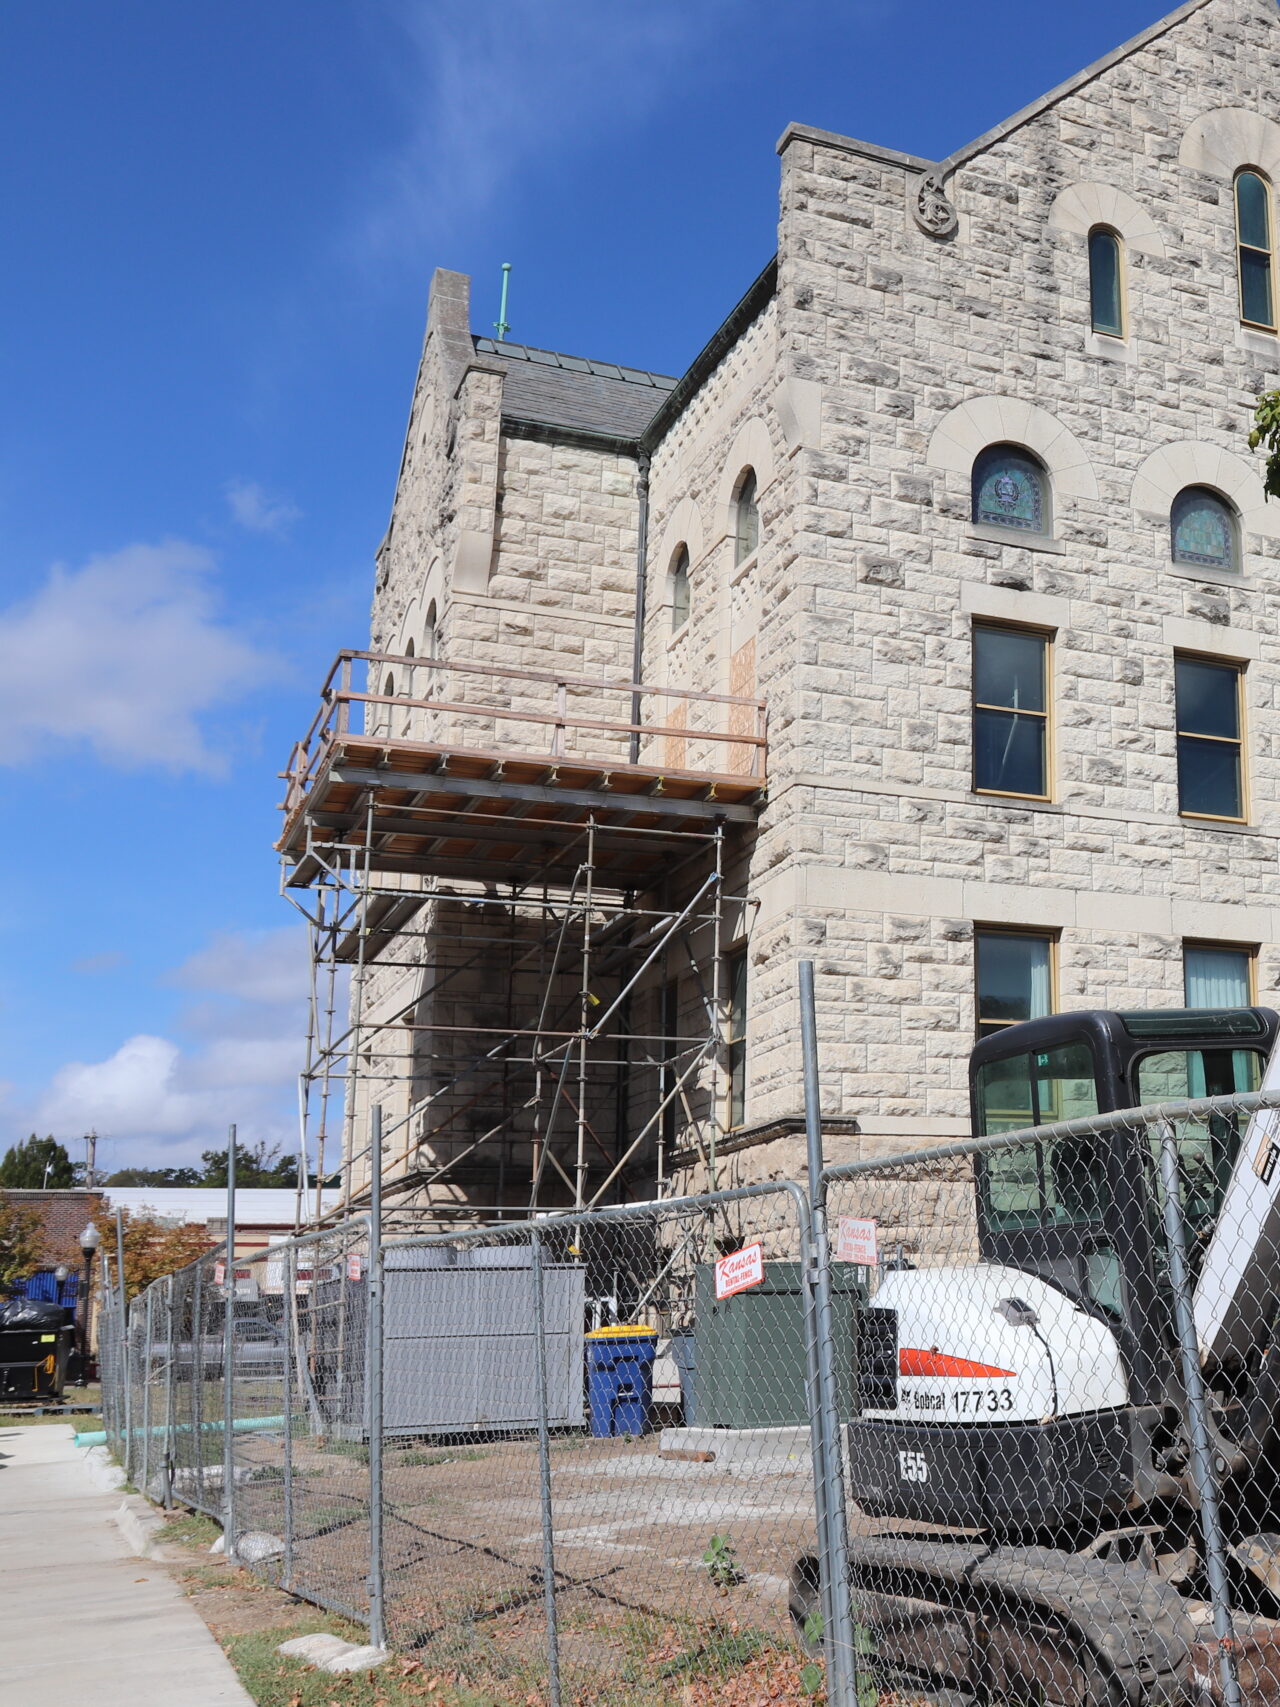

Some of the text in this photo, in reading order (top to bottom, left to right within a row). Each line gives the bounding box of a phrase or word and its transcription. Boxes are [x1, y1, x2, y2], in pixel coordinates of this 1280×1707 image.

[841, 1220, 871, 1241] Kansas
[719, 1250, 757, 1281] Kansas
[914, 1389, 1013, 1413] Bobcat 17733
[899, 1450, 927, 1483] E55
